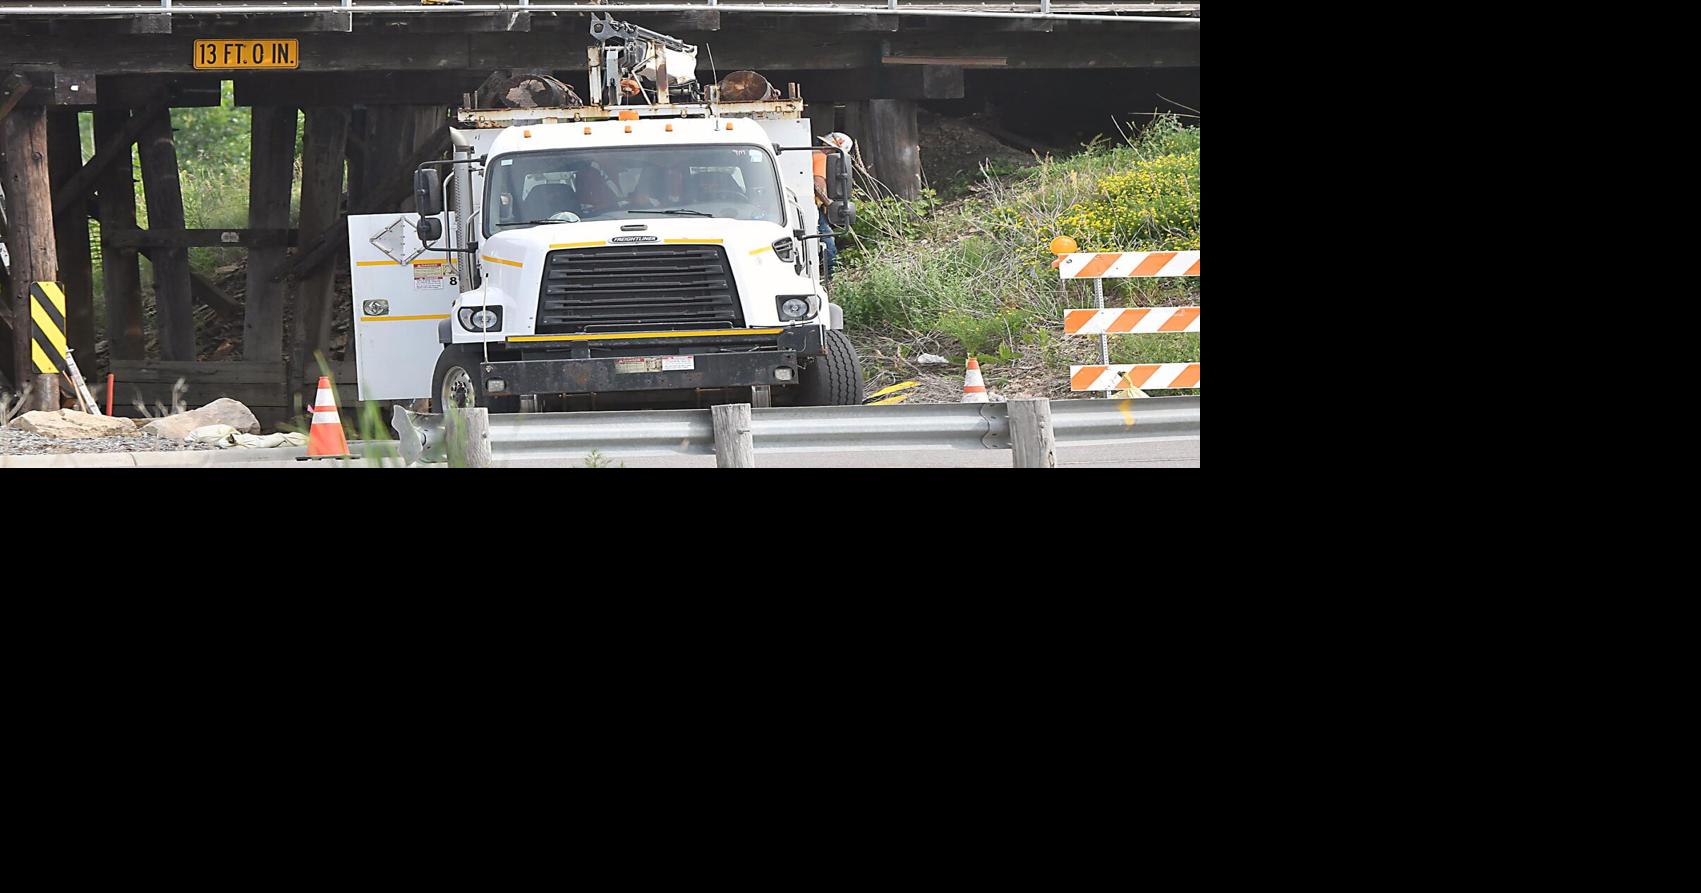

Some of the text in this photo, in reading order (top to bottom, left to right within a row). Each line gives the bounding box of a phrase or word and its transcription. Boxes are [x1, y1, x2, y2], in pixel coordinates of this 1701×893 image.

[200, 43, 294, 64] 13 FT. 0 IN.
[450, 277, 457, 285] 8
